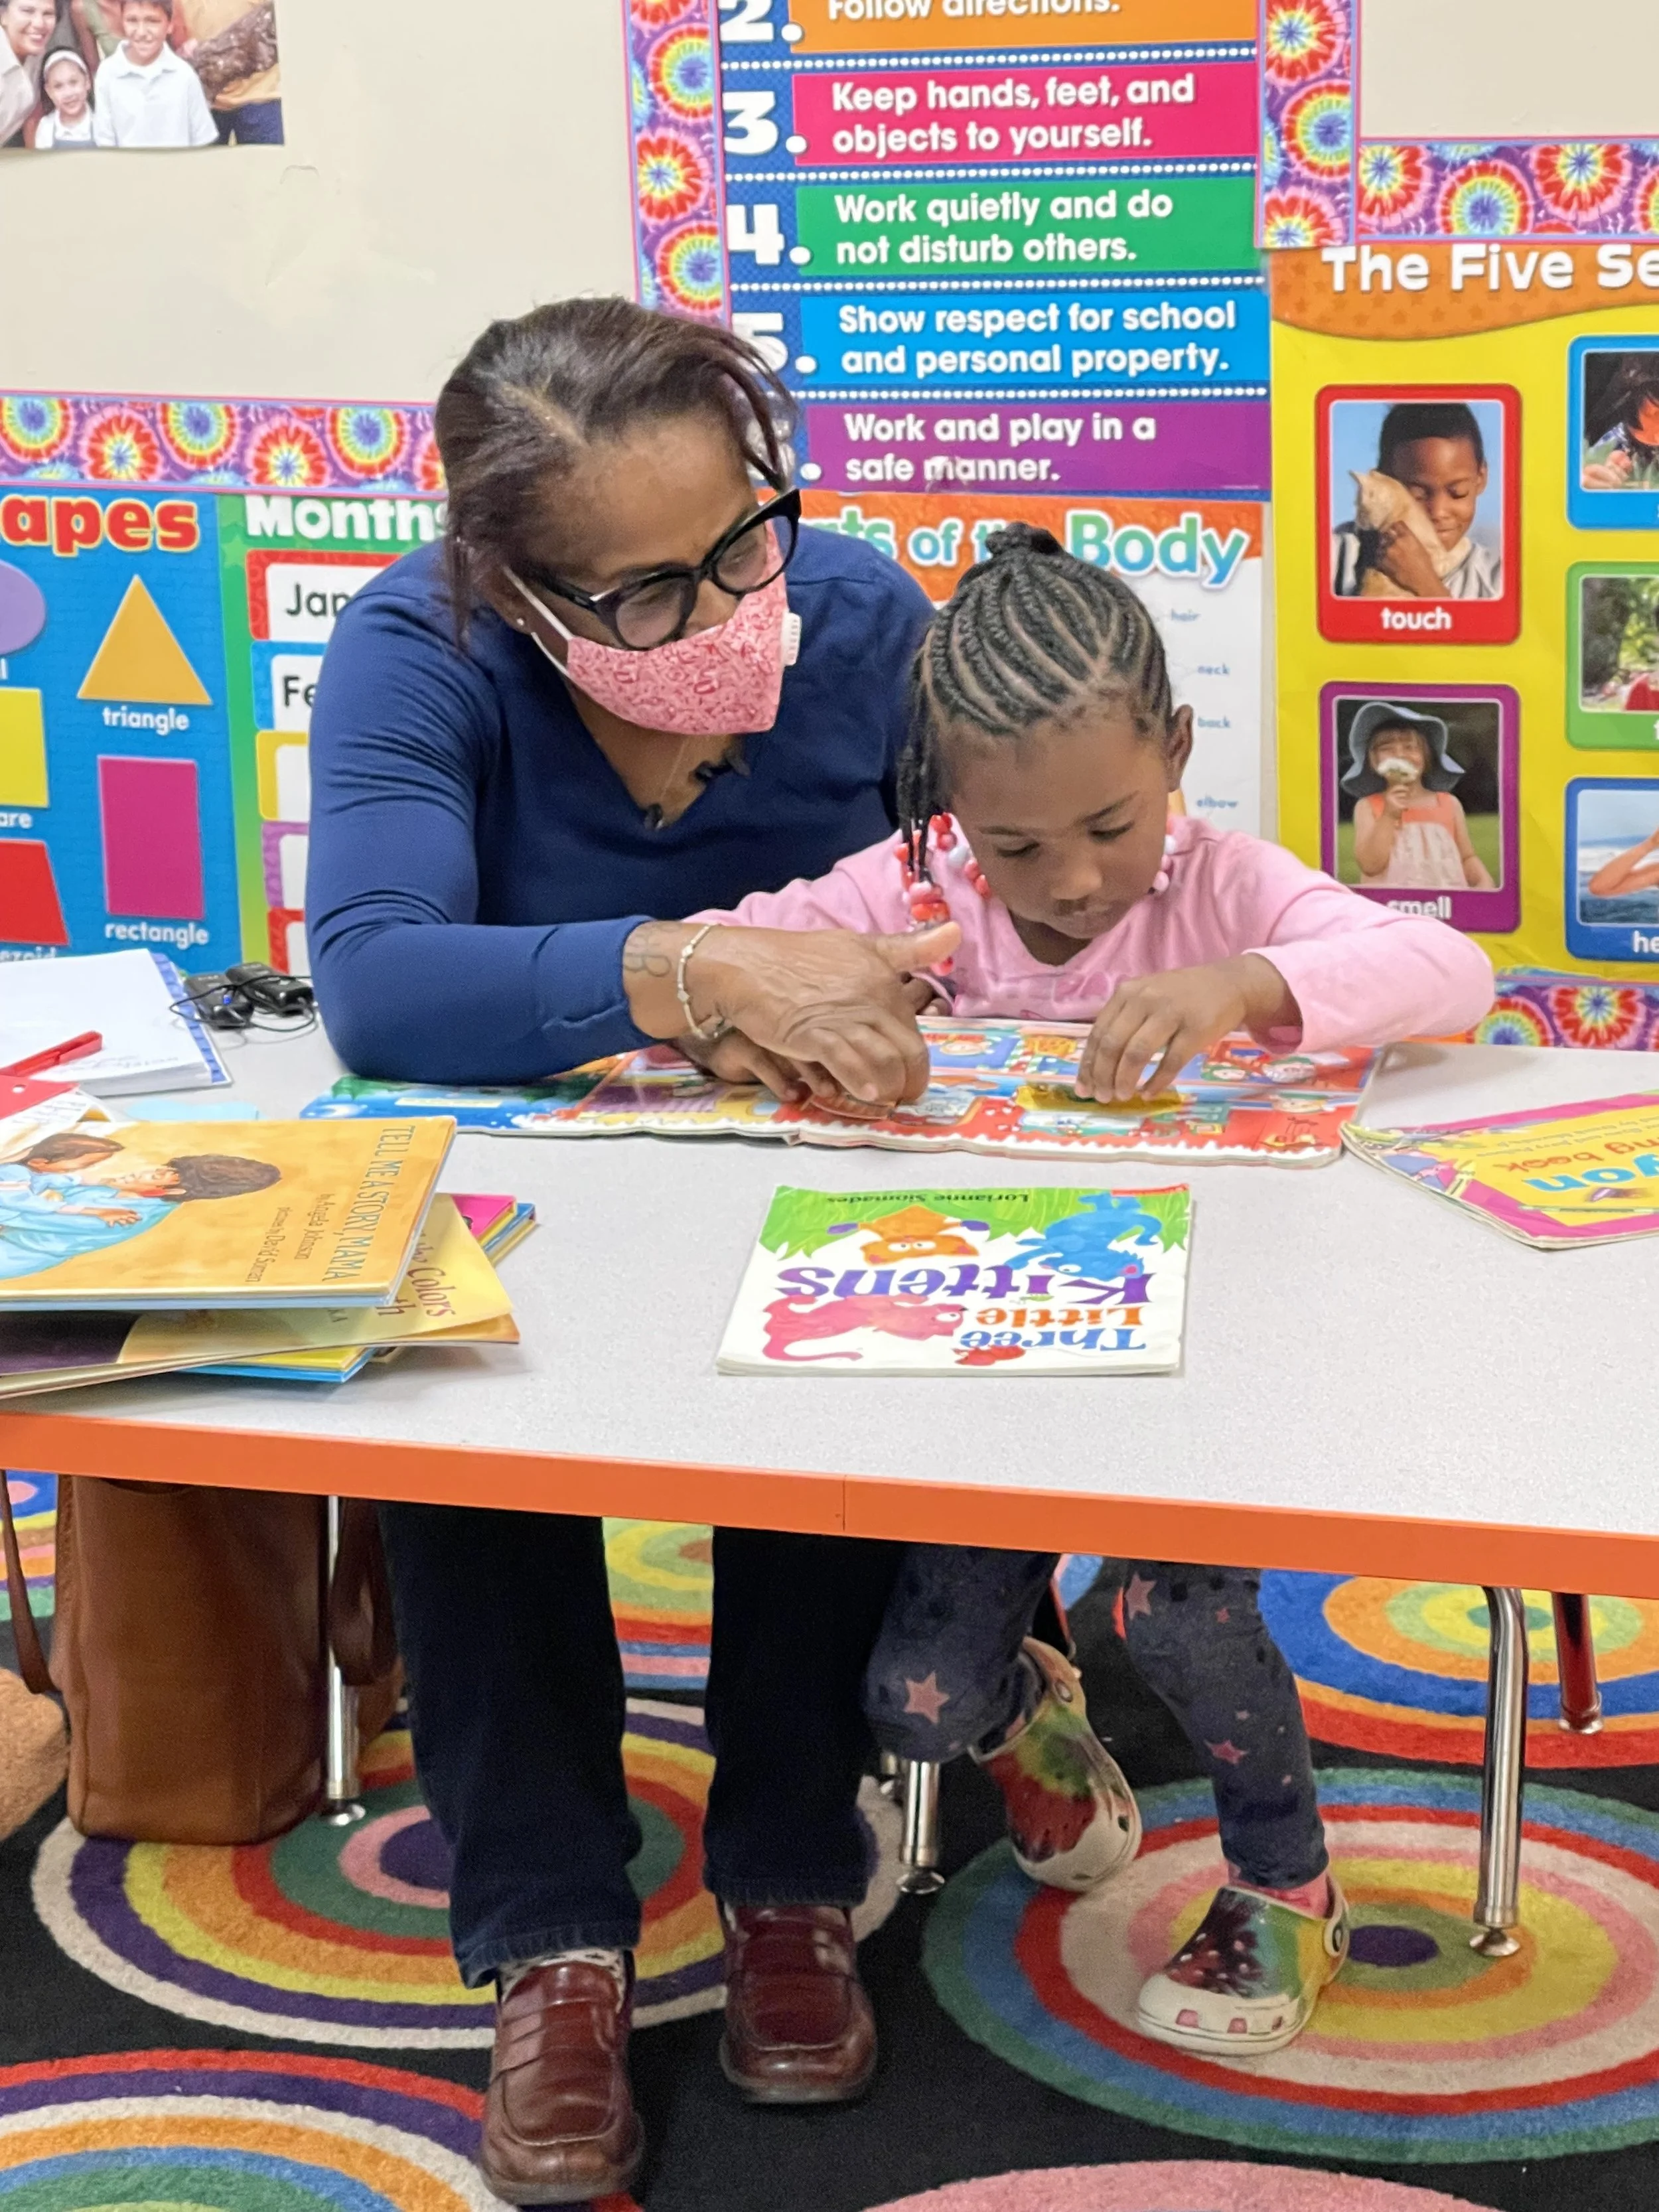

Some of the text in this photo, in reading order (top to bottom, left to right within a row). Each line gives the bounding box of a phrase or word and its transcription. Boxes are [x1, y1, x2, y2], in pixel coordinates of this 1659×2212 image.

[719, 0, 803, 43] 2.
[829, 0, 1120, 20] Follow directions.
[832, 72, 1194, 116] Keep hands, feet, and
[722, 91, 808, 155] 3.
[833, 116, 1153, 160] objects to yourself.
[834, 188, 1173, 228] Work quietly and do
[725, 203, 812, 265] 4.
[837, 232, 1137, 265] not disturb others.
[1321, 244, 1430, 292] The
[1450, 243, 1573, 291] Five
[839, 300, 1236, 338] Show respect for school
[841, 342, 1230, 380] and personal property.
[843, 412, 1156, 447] Work and play in a
[845, 453, 1061, 482] safe manner.
[0, 494, 199, 557] apes
[908, 518, 964, 567] of
[1066, 510, 1249, 588] Body
[1381, 607, 1452, 630] touch
[1197, 663, 1230, 675] neck
[103, 707, 190, 735] triangle
[1196, 796, 1239, 809] elbow
[104, 921, 210, 950] rectangle
[374, 1126, 416, 1156] TELL
[365, 1159, 403, 1178] ME
[1492, 1152, 1605, 1173] book
[359, 1180, 396, 1190] A
[322, 1234, 374, 1282] MAMA
[406, 1267, 457, 1317] Colors
[774, 1263, 1157, 1305] Kittens
[975, 1306, 1145, 1327] Little
[960, 1328, 1147, 1351] Three
